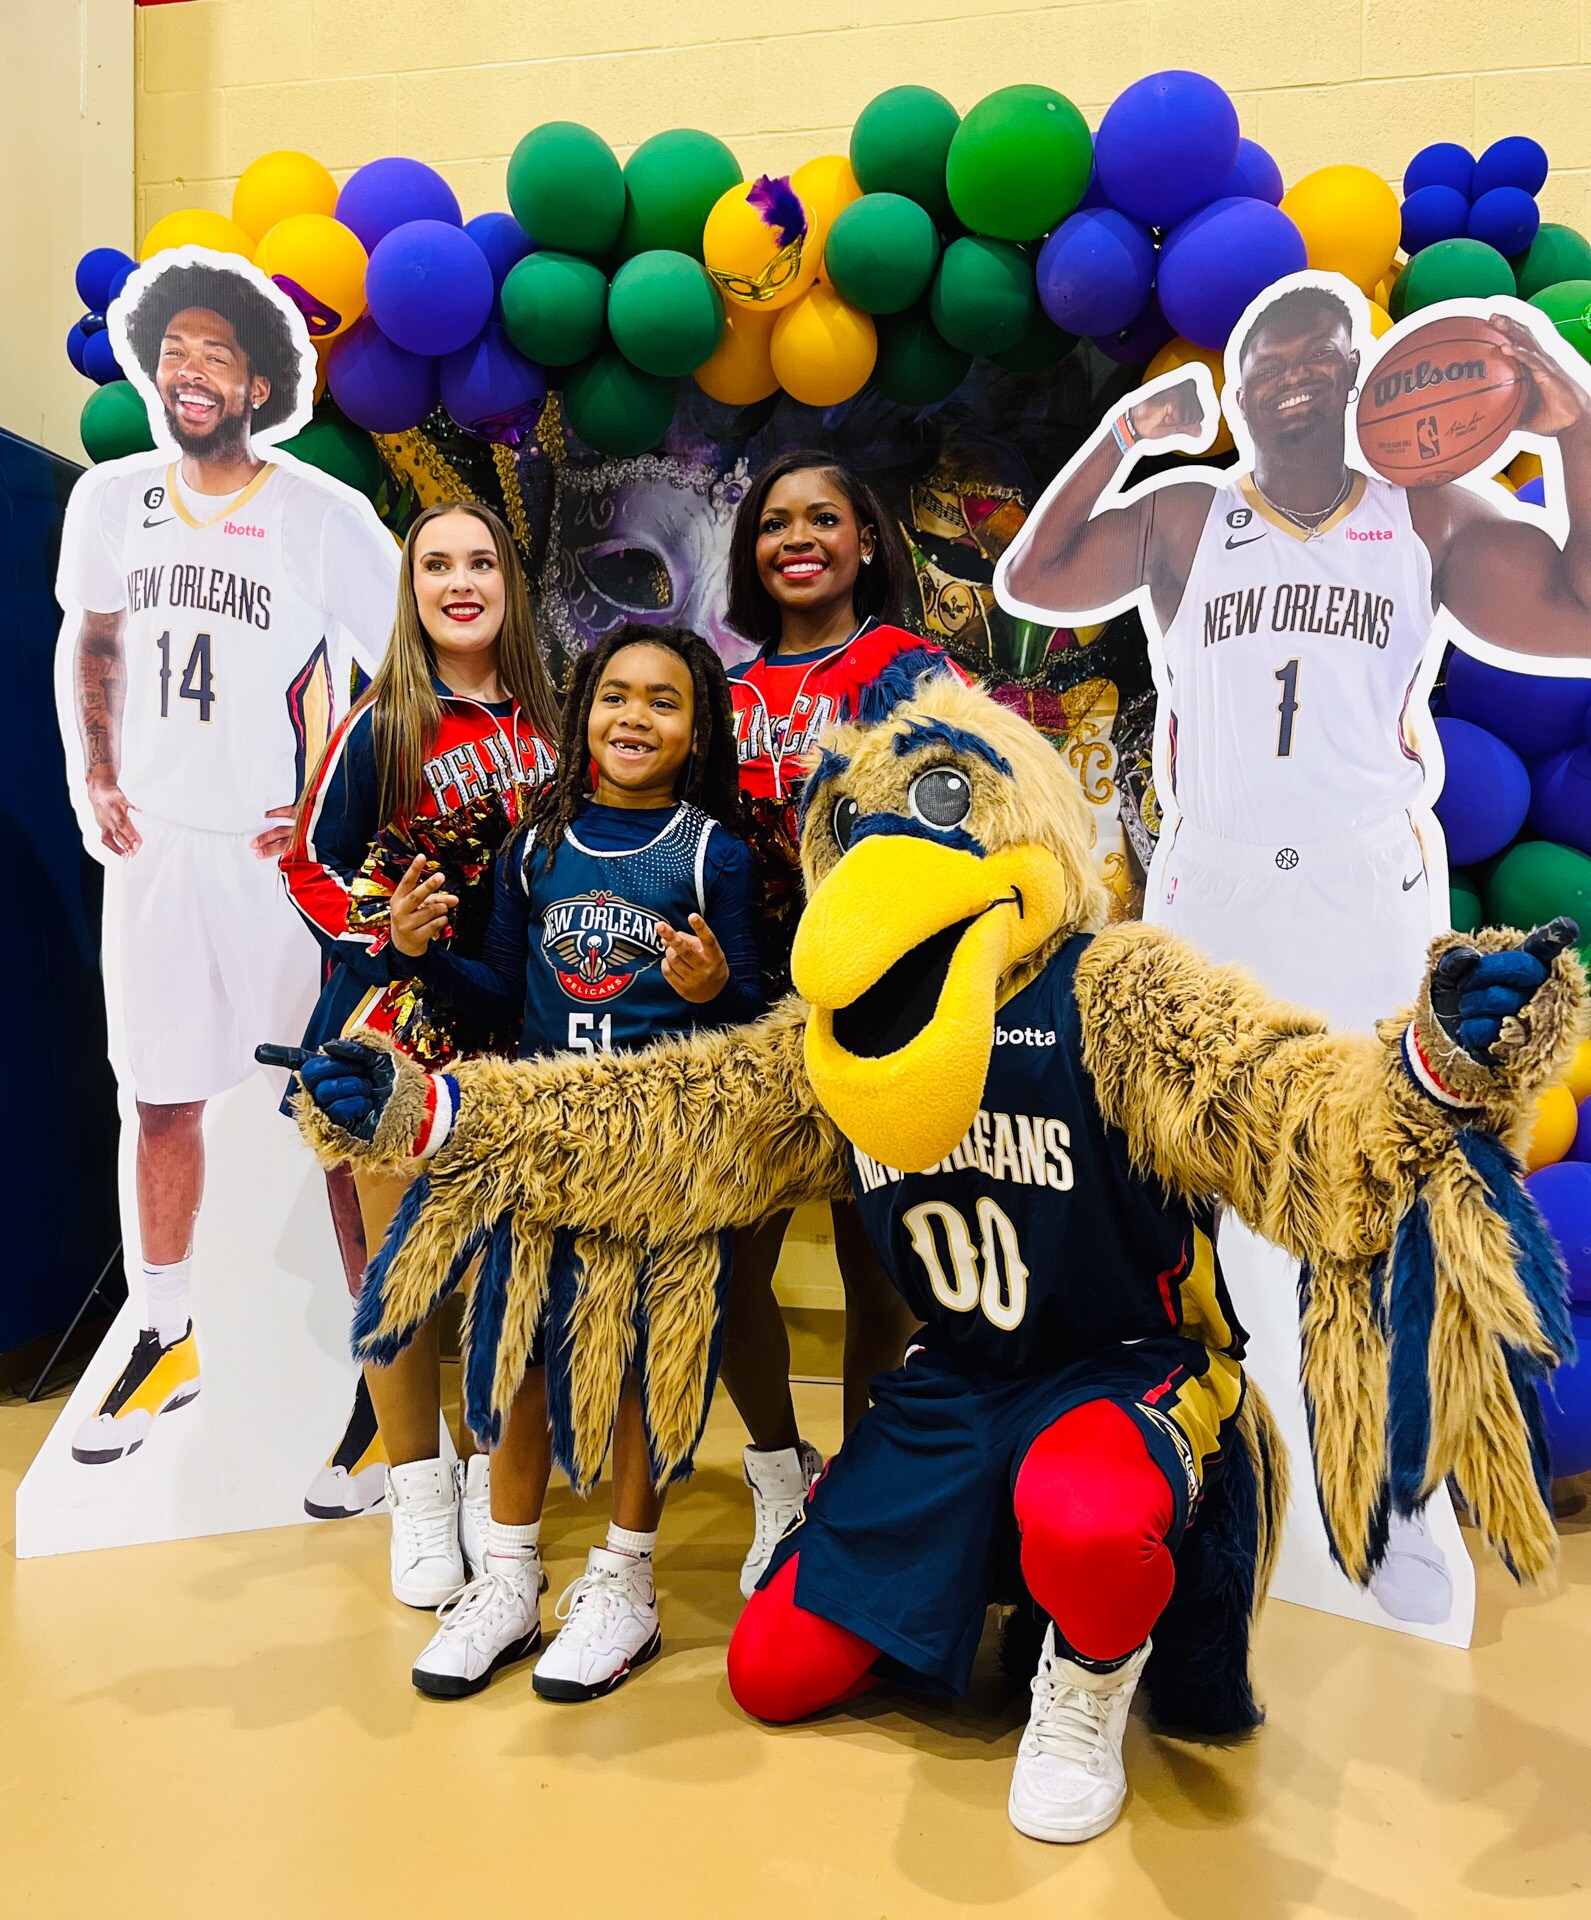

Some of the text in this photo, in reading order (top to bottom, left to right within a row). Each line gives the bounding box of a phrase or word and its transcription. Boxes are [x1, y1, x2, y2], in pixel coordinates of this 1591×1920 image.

[1372, 358, 1488, 409] Wilson
[148, 488, 164, 508] 6
[1229, 510, 1250, 527] 6
[223, 521, 266, 539] ibotta
[1345, 527, 1393, 542] ibotta
[127, 563, 272, 631] NEW ORLEANS
[1203, 583, 1395, 650] NEW ORLEANS
[156, 627, 218, 725] 14
[1272, 656, 1302, 759] 1
[543, 906, 666, 952] NEW ORLEAN
[565, 977, 623, 996] PELICANS
[568, 1012, 612, 1057] 51
[919, 1108, 1075, 1192] LEANS
[902, 1196, 1030, 1332] 00
